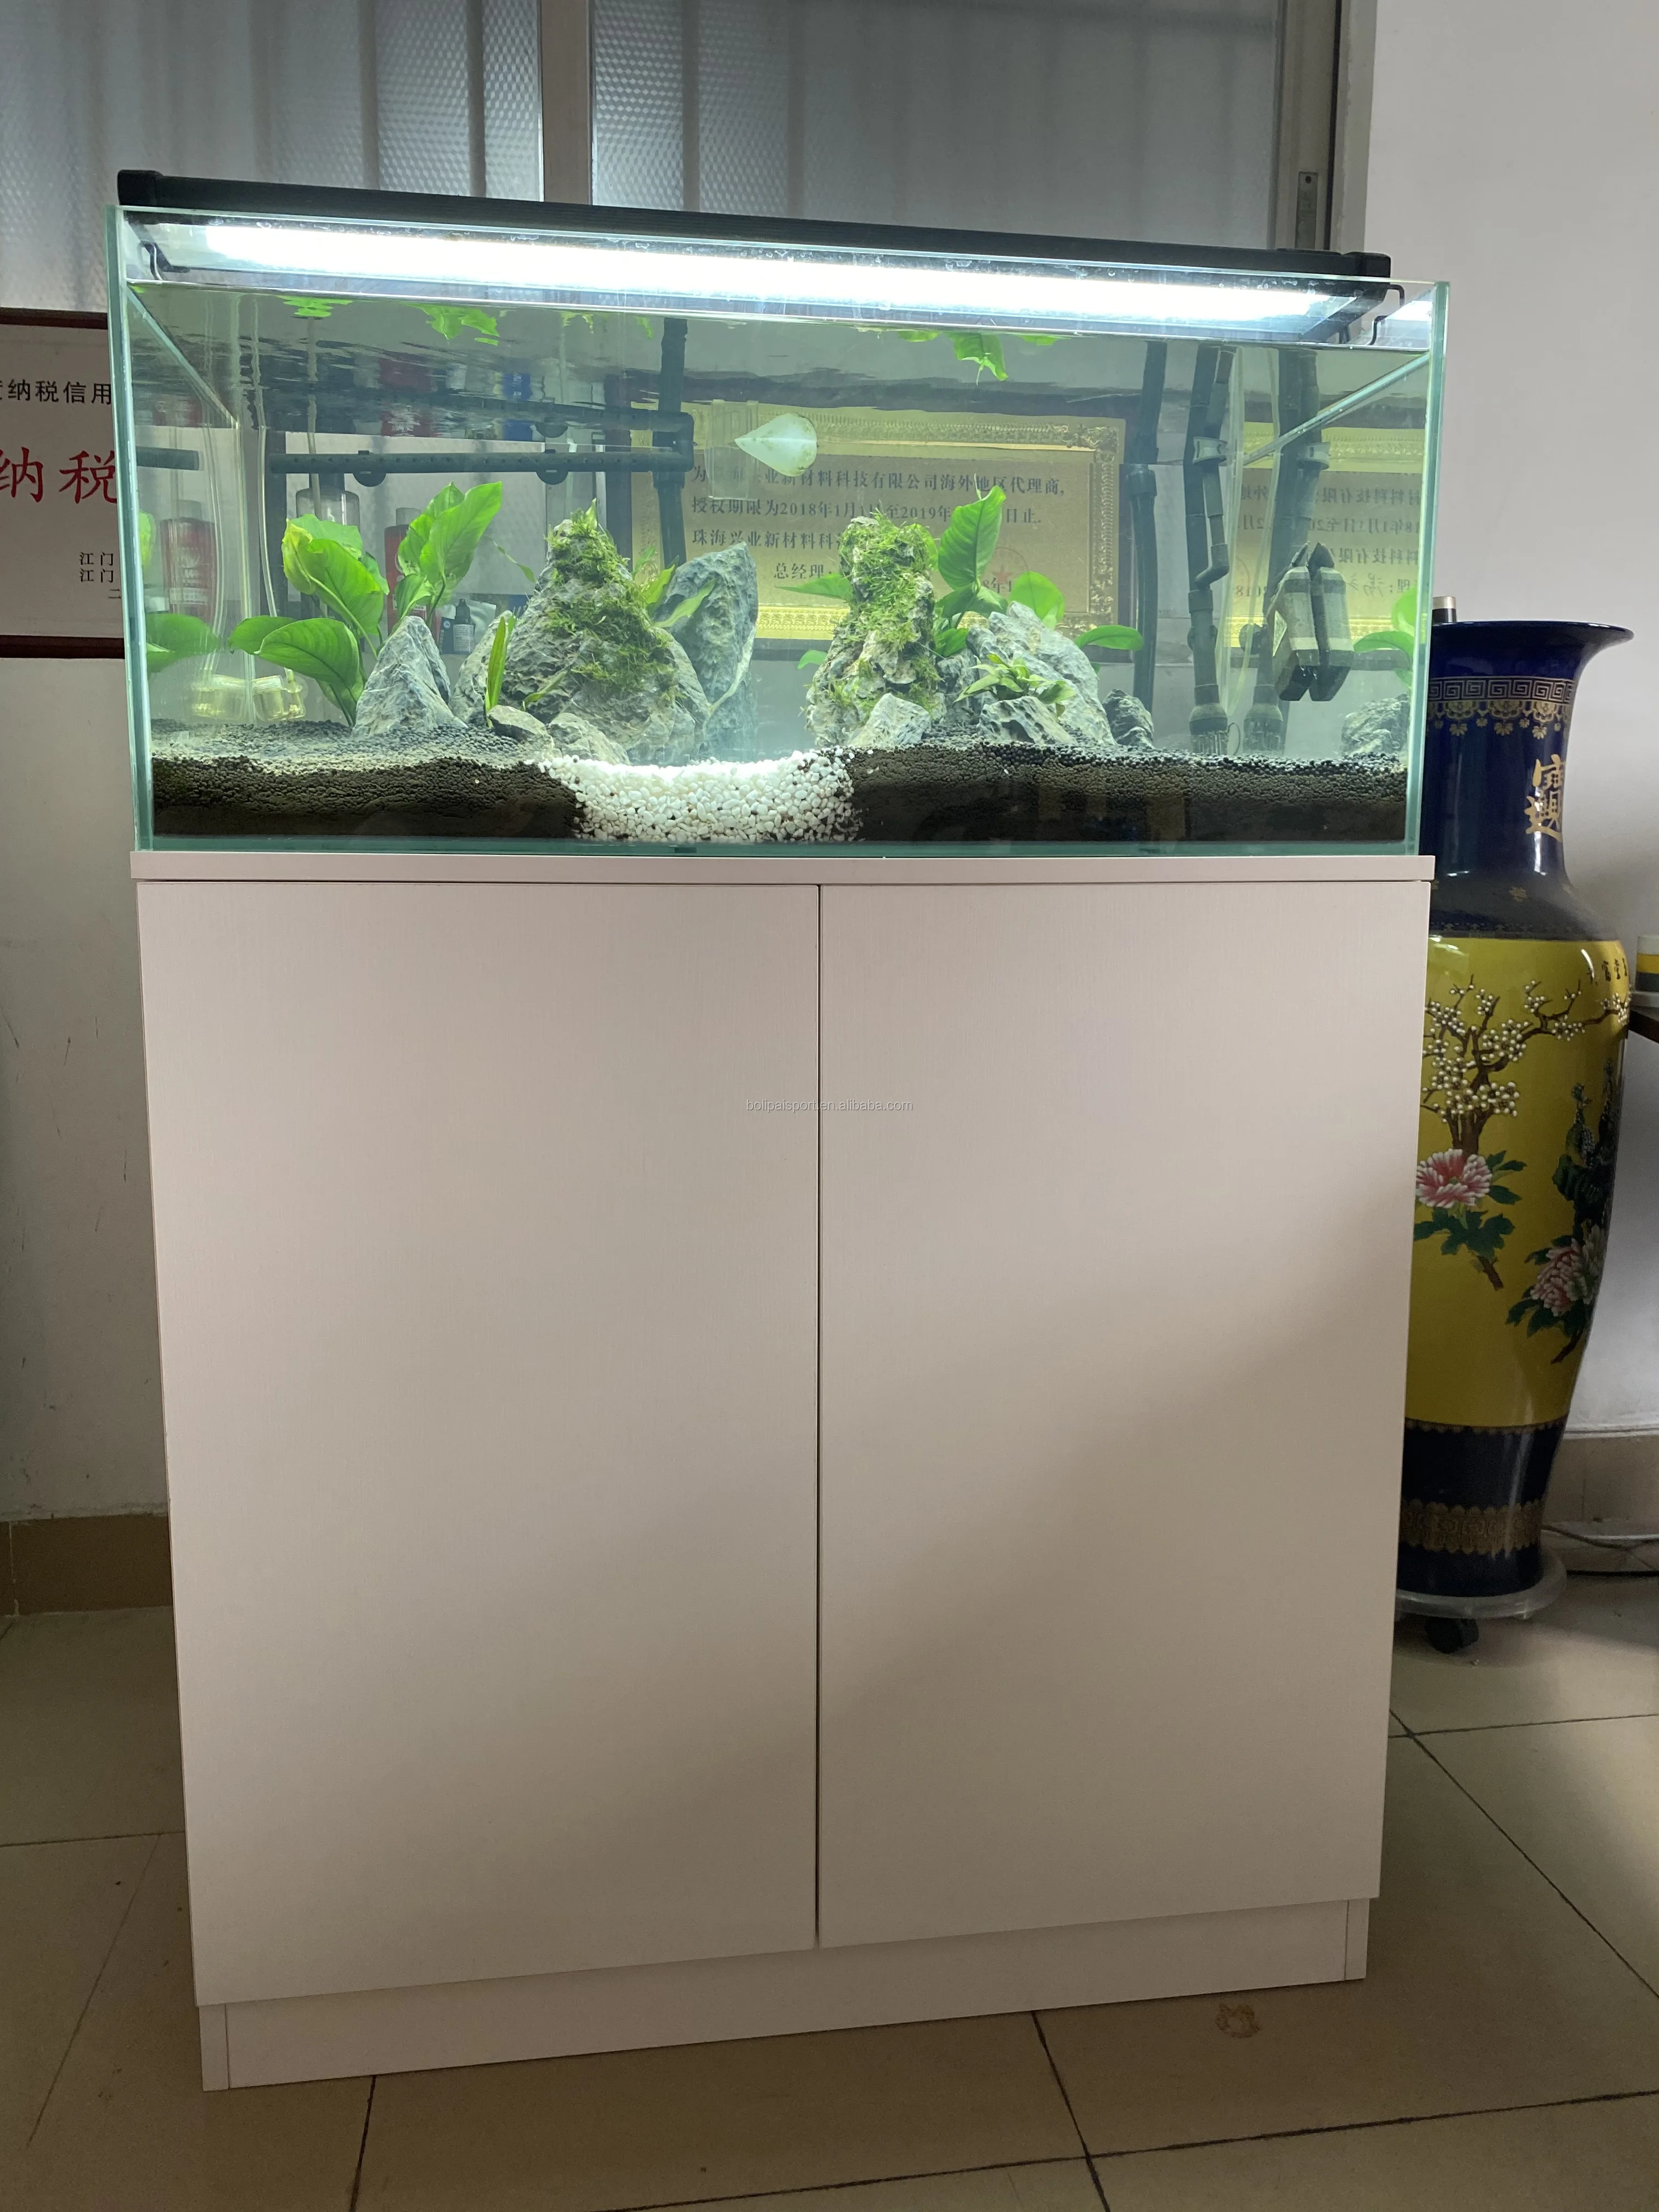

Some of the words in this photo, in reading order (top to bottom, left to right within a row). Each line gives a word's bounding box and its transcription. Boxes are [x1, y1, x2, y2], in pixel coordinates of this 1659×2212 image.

[0, 379, 112, 405] 纳税信用
[0, 447, 117, 504] 纳税
[80, 552, 114, 566] 江门
[80, 568, 114, 583] 江门
